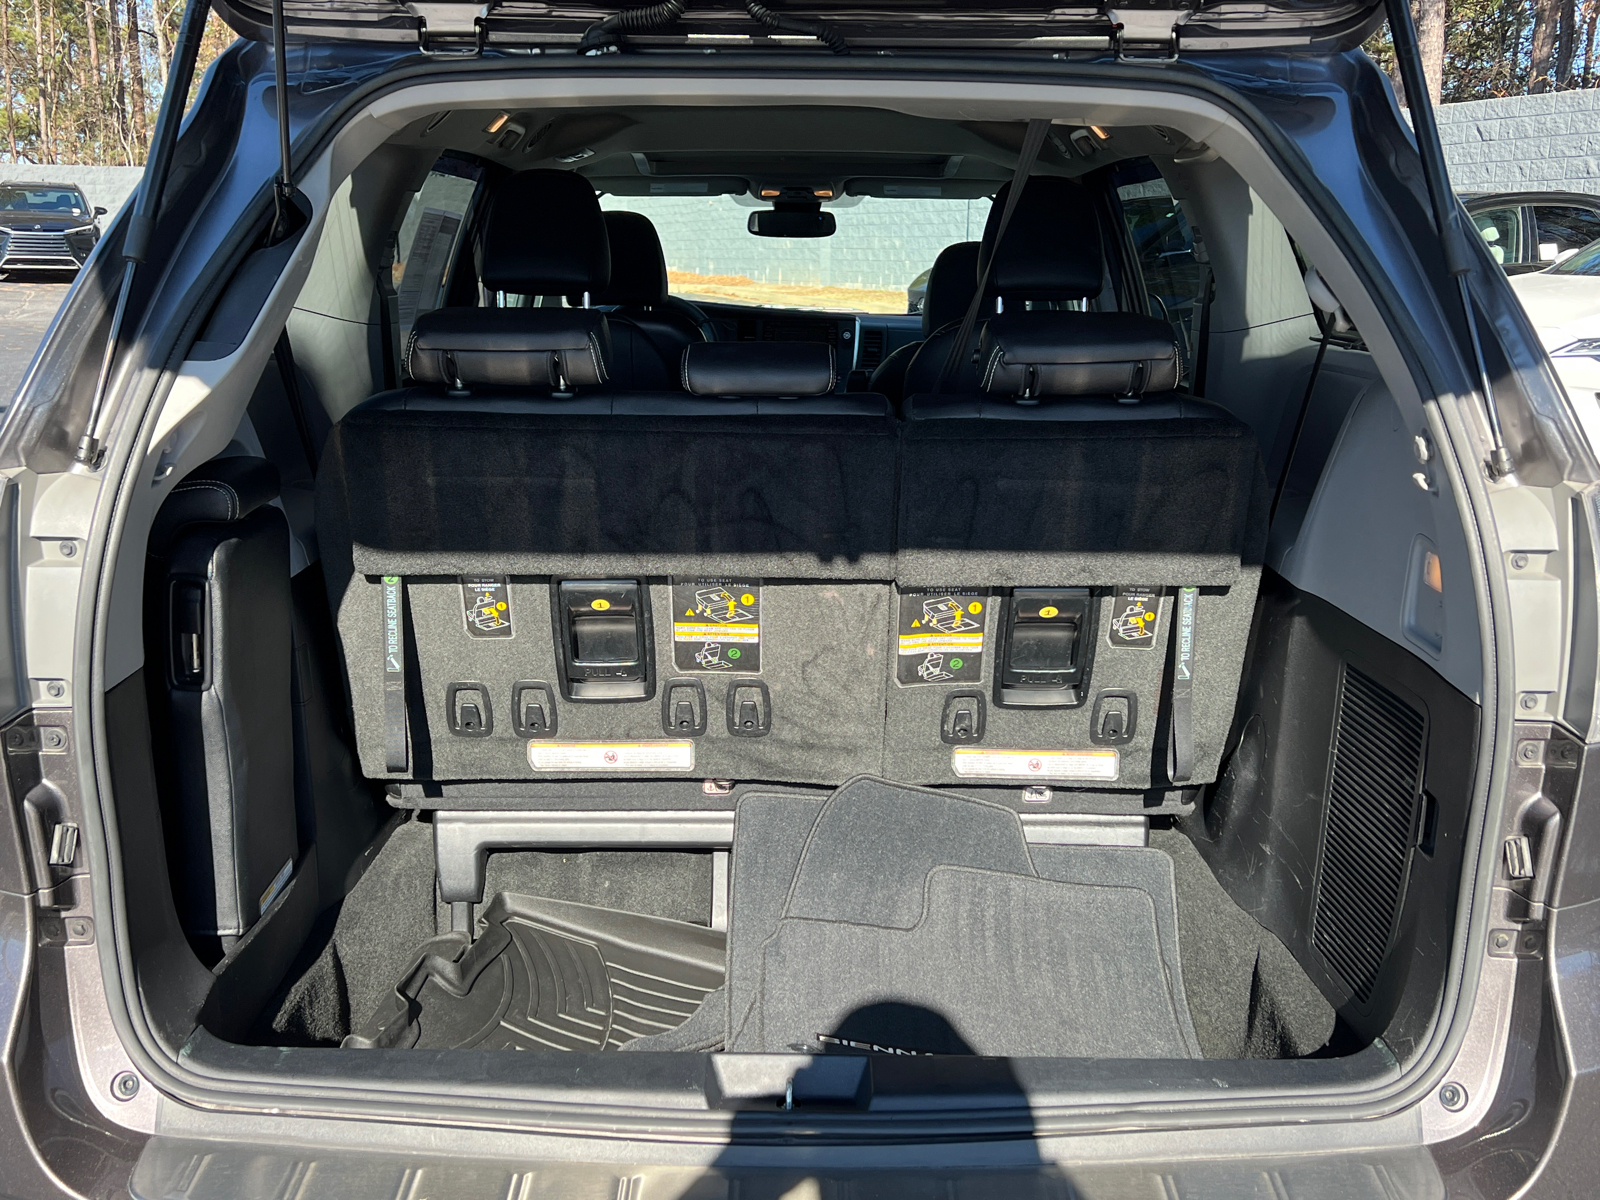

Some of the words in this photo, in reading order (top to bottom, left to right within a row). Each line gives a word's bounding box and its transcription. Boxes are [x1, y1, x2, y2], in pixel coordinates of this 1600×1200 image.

[387, 586, 397, 617] SEATBACK
[388, 618, 397, 644] RECLINE
[1182, 626, 1192, 652] RECLINE
[389, 645, 398, 653] TO
[1181, 652, 1190, 661] TO
[817, 1034, 934, 1056] SIENN
